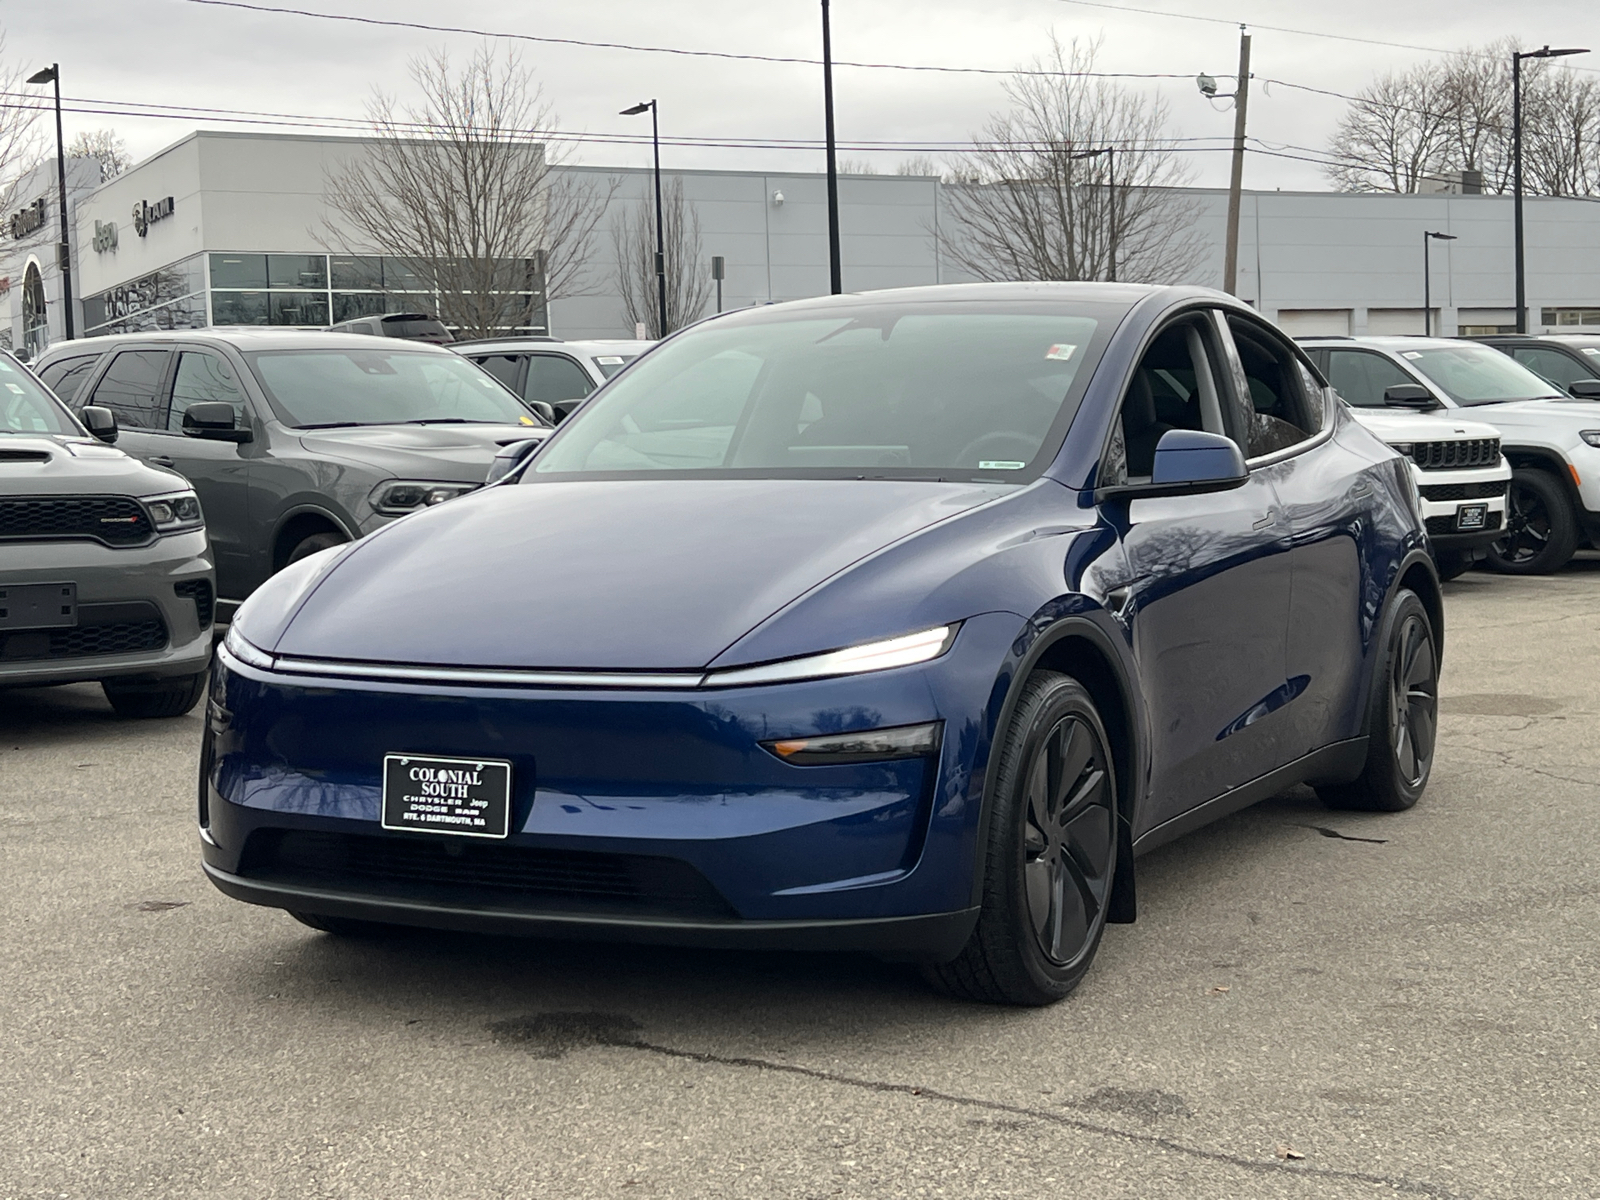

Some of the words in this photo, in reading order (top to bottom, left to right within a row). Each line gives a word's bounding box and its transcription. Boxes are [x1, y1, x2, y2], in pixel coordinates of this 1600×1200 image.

[145, 196, 174, 224] RAM
[92, 219, 118, 254] Jeep
[409, 767, 482, 786] COLONIAL
[421, 782, 469, 798] SOUTH
[402, 795, 463, 806] CHRYSLER
[469, 798, 489, 809] Jeep
[410, 804, 448, 813] DODGE
[454, 808, 480, 816] RAM
[403, 812, 419, 821] RTE.
[426, 813, 473, 826] DARTMOUTH,
[473, 818, 486, 826] MA
